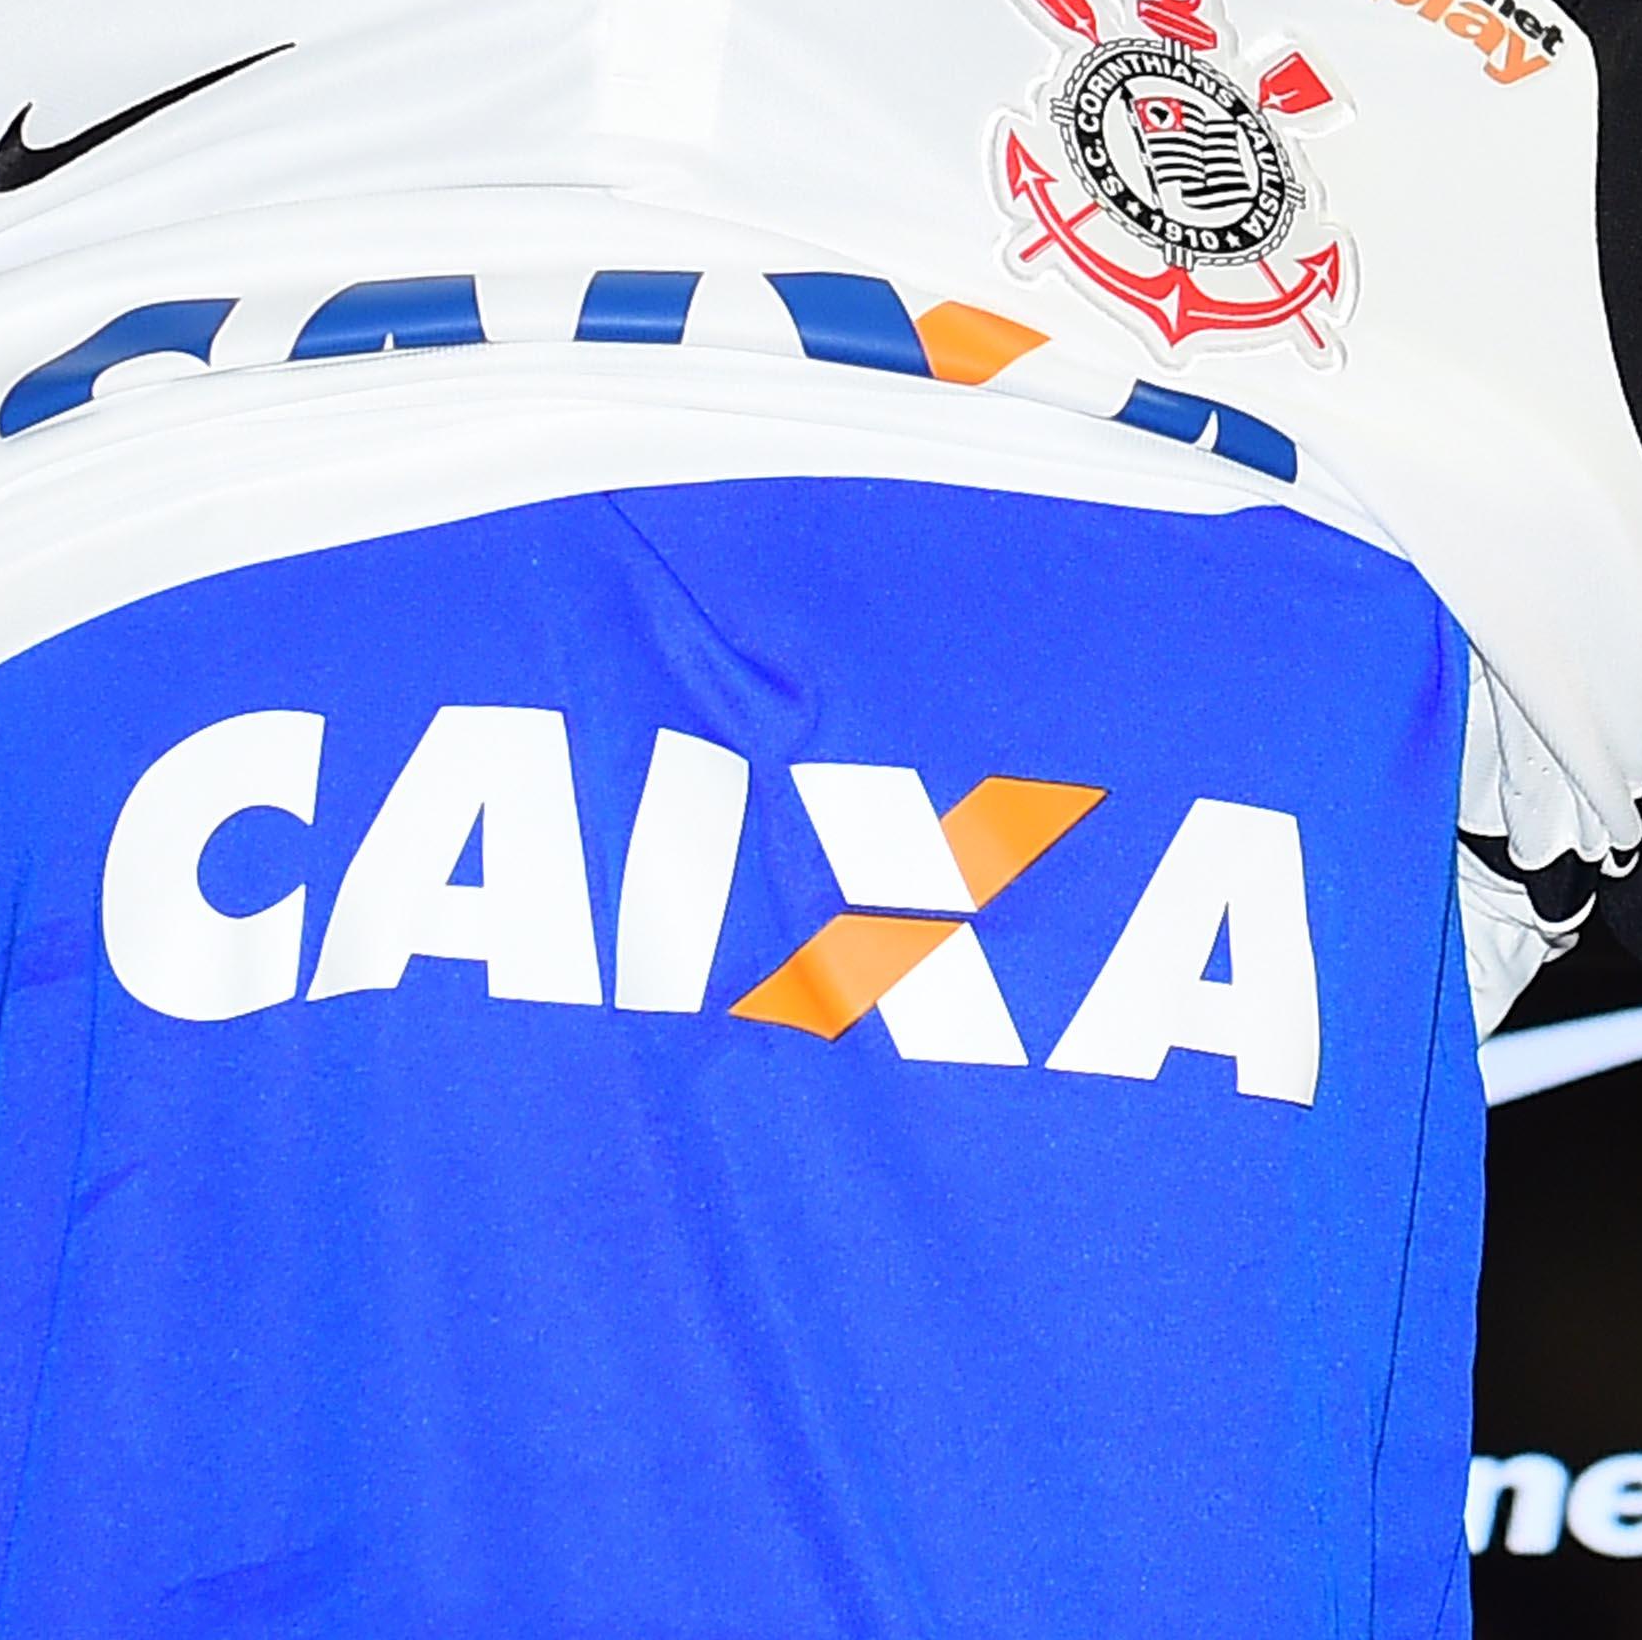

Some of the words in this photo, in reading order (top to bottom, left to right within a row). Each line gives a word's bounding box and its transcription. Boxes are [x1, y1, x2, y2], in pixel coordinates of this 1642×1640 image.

[1077, 53, 1236, 133] CORINTHIANS
[1236, 113, 1282, 240] PAULISTA
[1150, 214, 1220, 251] 1910
[102, 705, 1322, 1108] CAIXA
